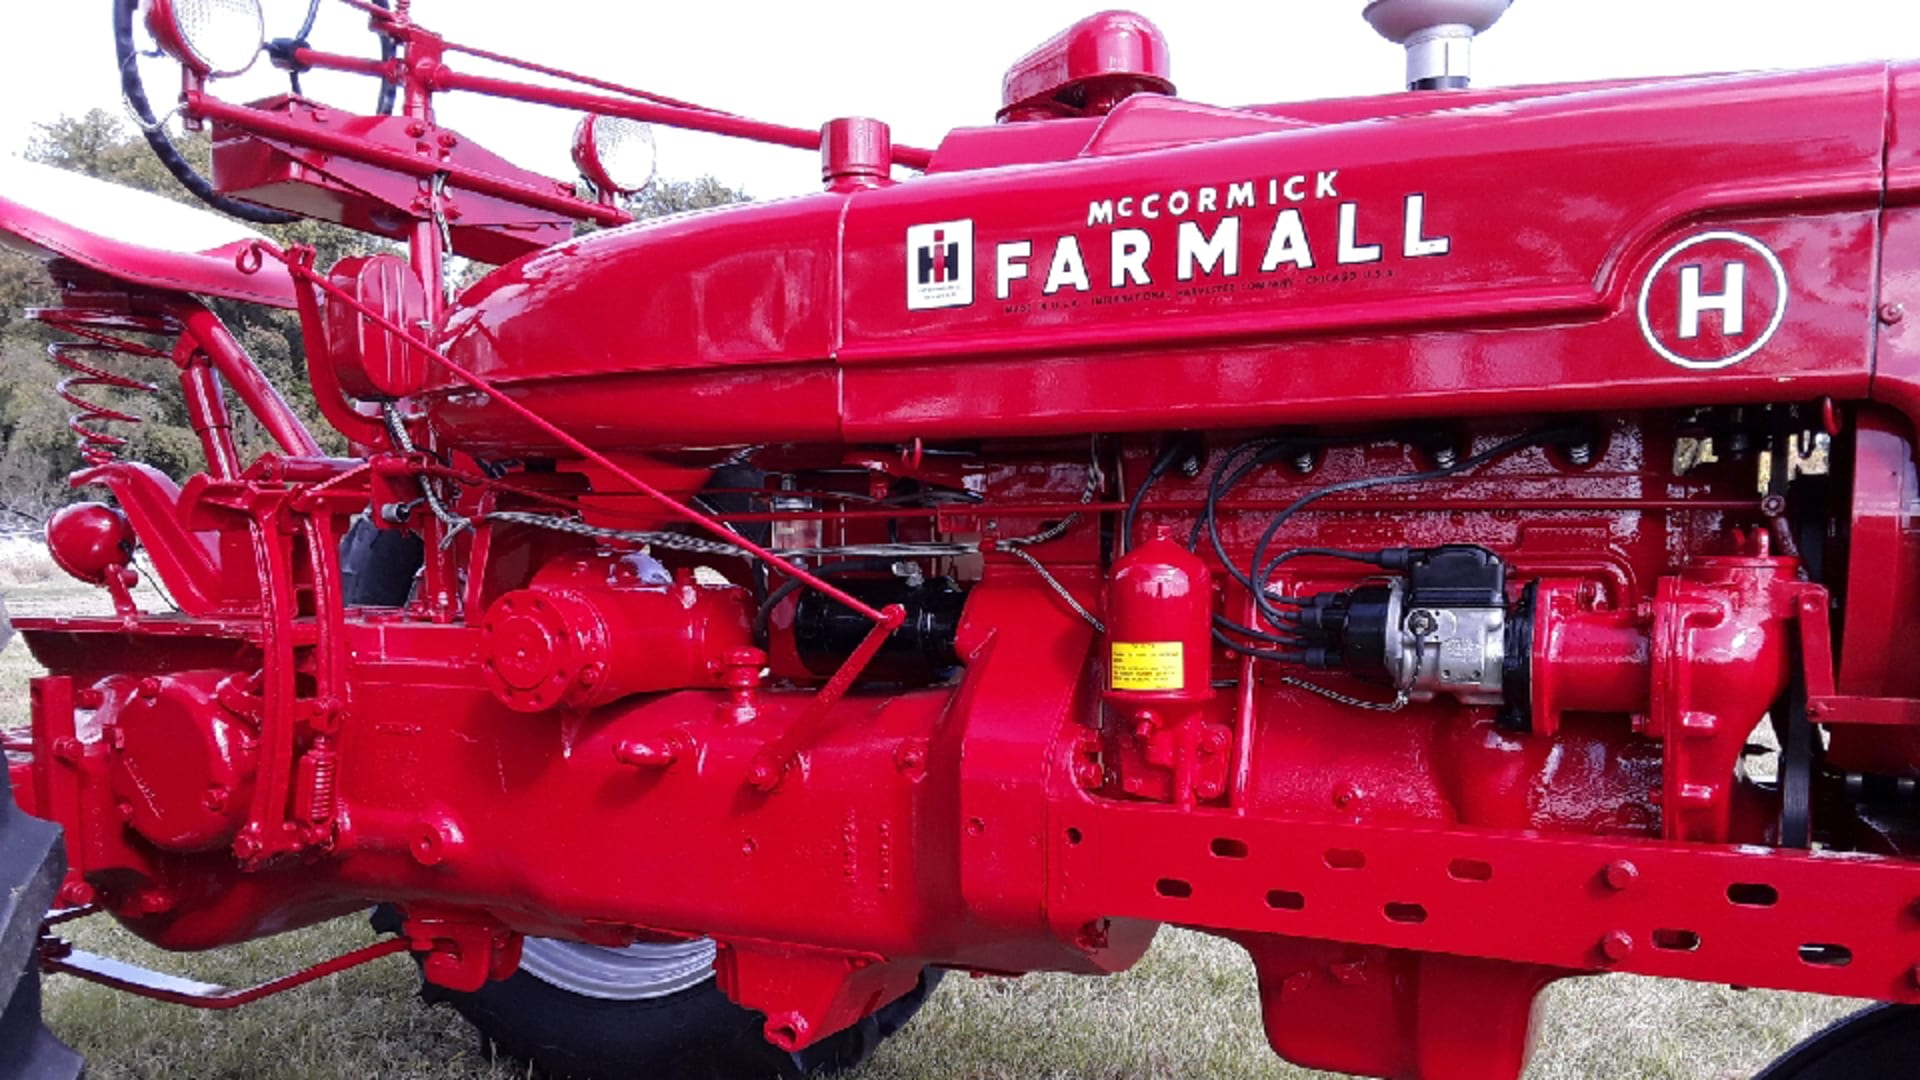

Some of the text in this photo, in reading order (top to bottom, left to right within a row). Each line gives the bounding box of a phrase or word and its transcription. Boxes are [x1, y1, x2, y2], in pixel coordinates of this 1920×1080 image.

[995, 193, 1450, 301] FARMALL
[1091, 291, 1171, 305] INTERNATONA
[1677, 261, 1745, 341] H
